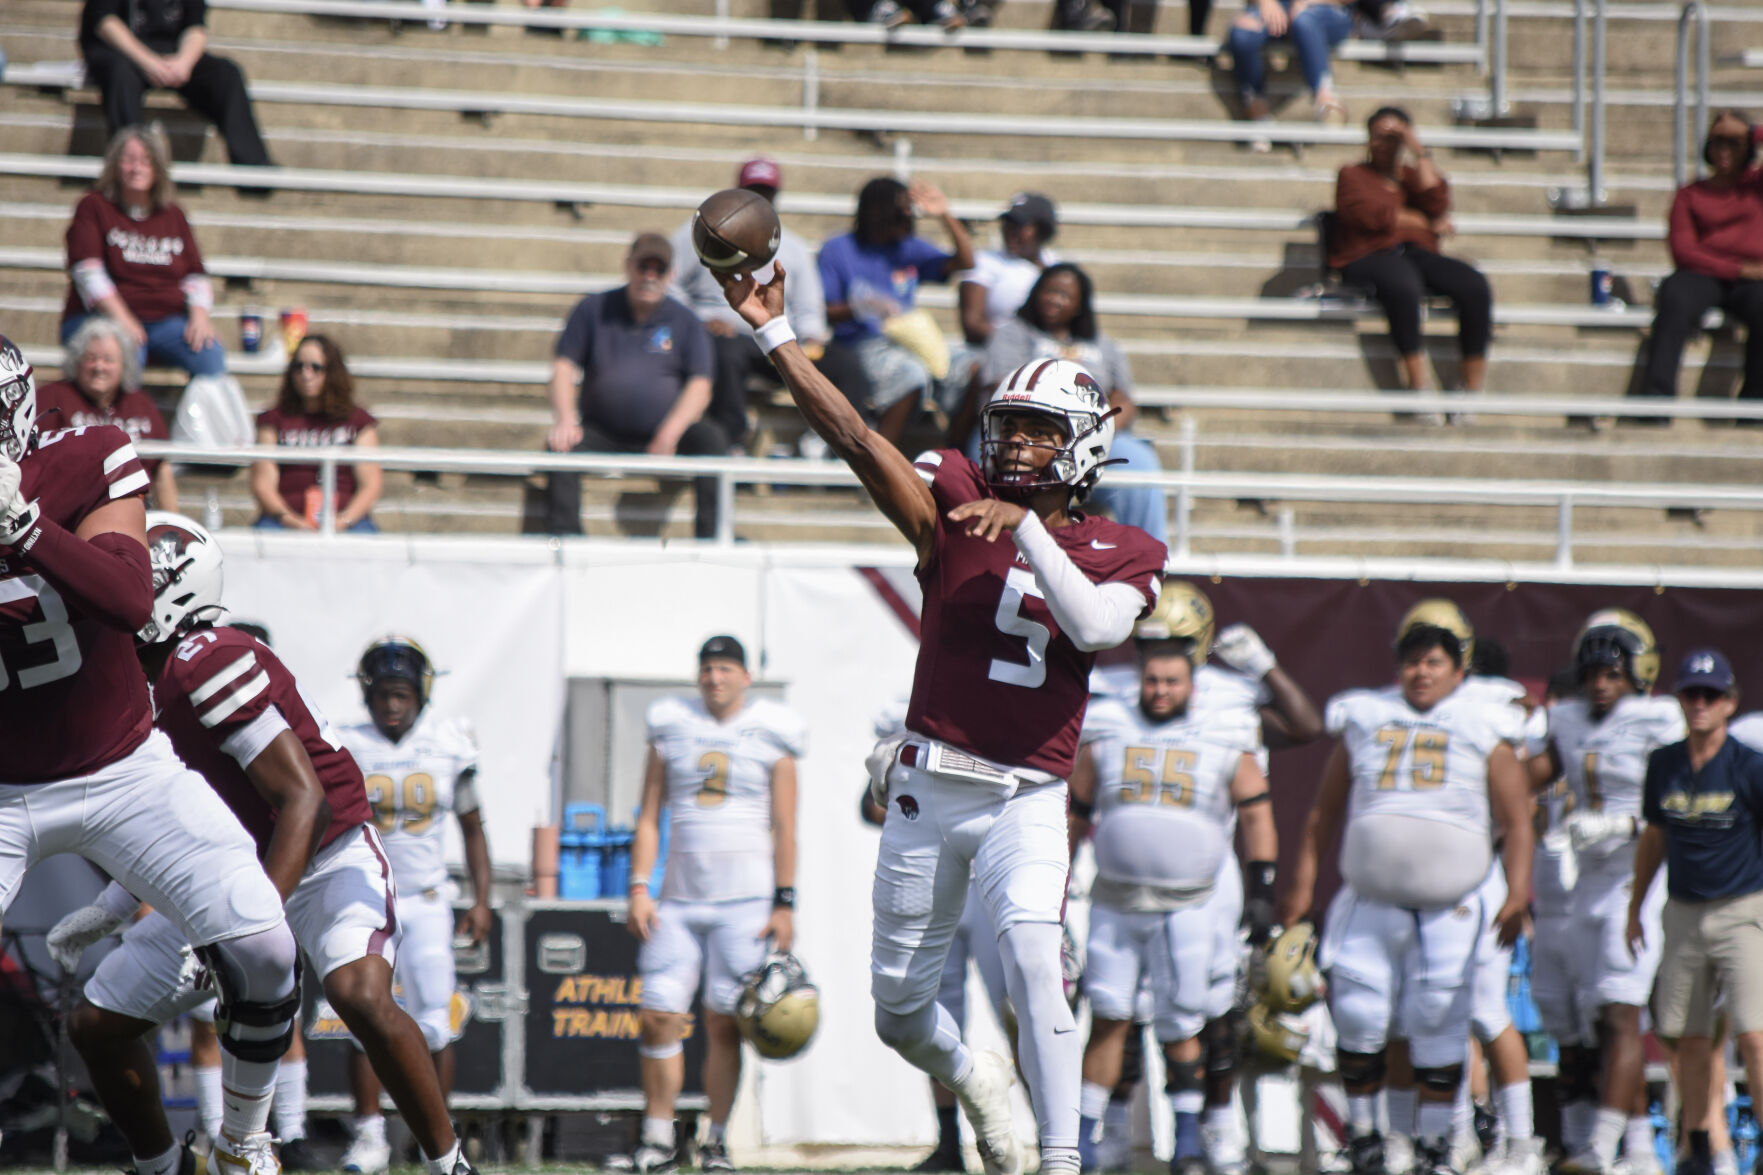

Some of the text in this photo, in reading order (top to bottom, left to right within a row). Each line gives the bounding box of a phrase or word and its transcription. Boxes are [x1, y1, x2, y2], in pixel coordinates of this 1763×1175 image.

[988, 566, 1051, 690] 5
[1120, 746, 1198, 808] 55
[553, 974, 643, 1004] ATHLE
